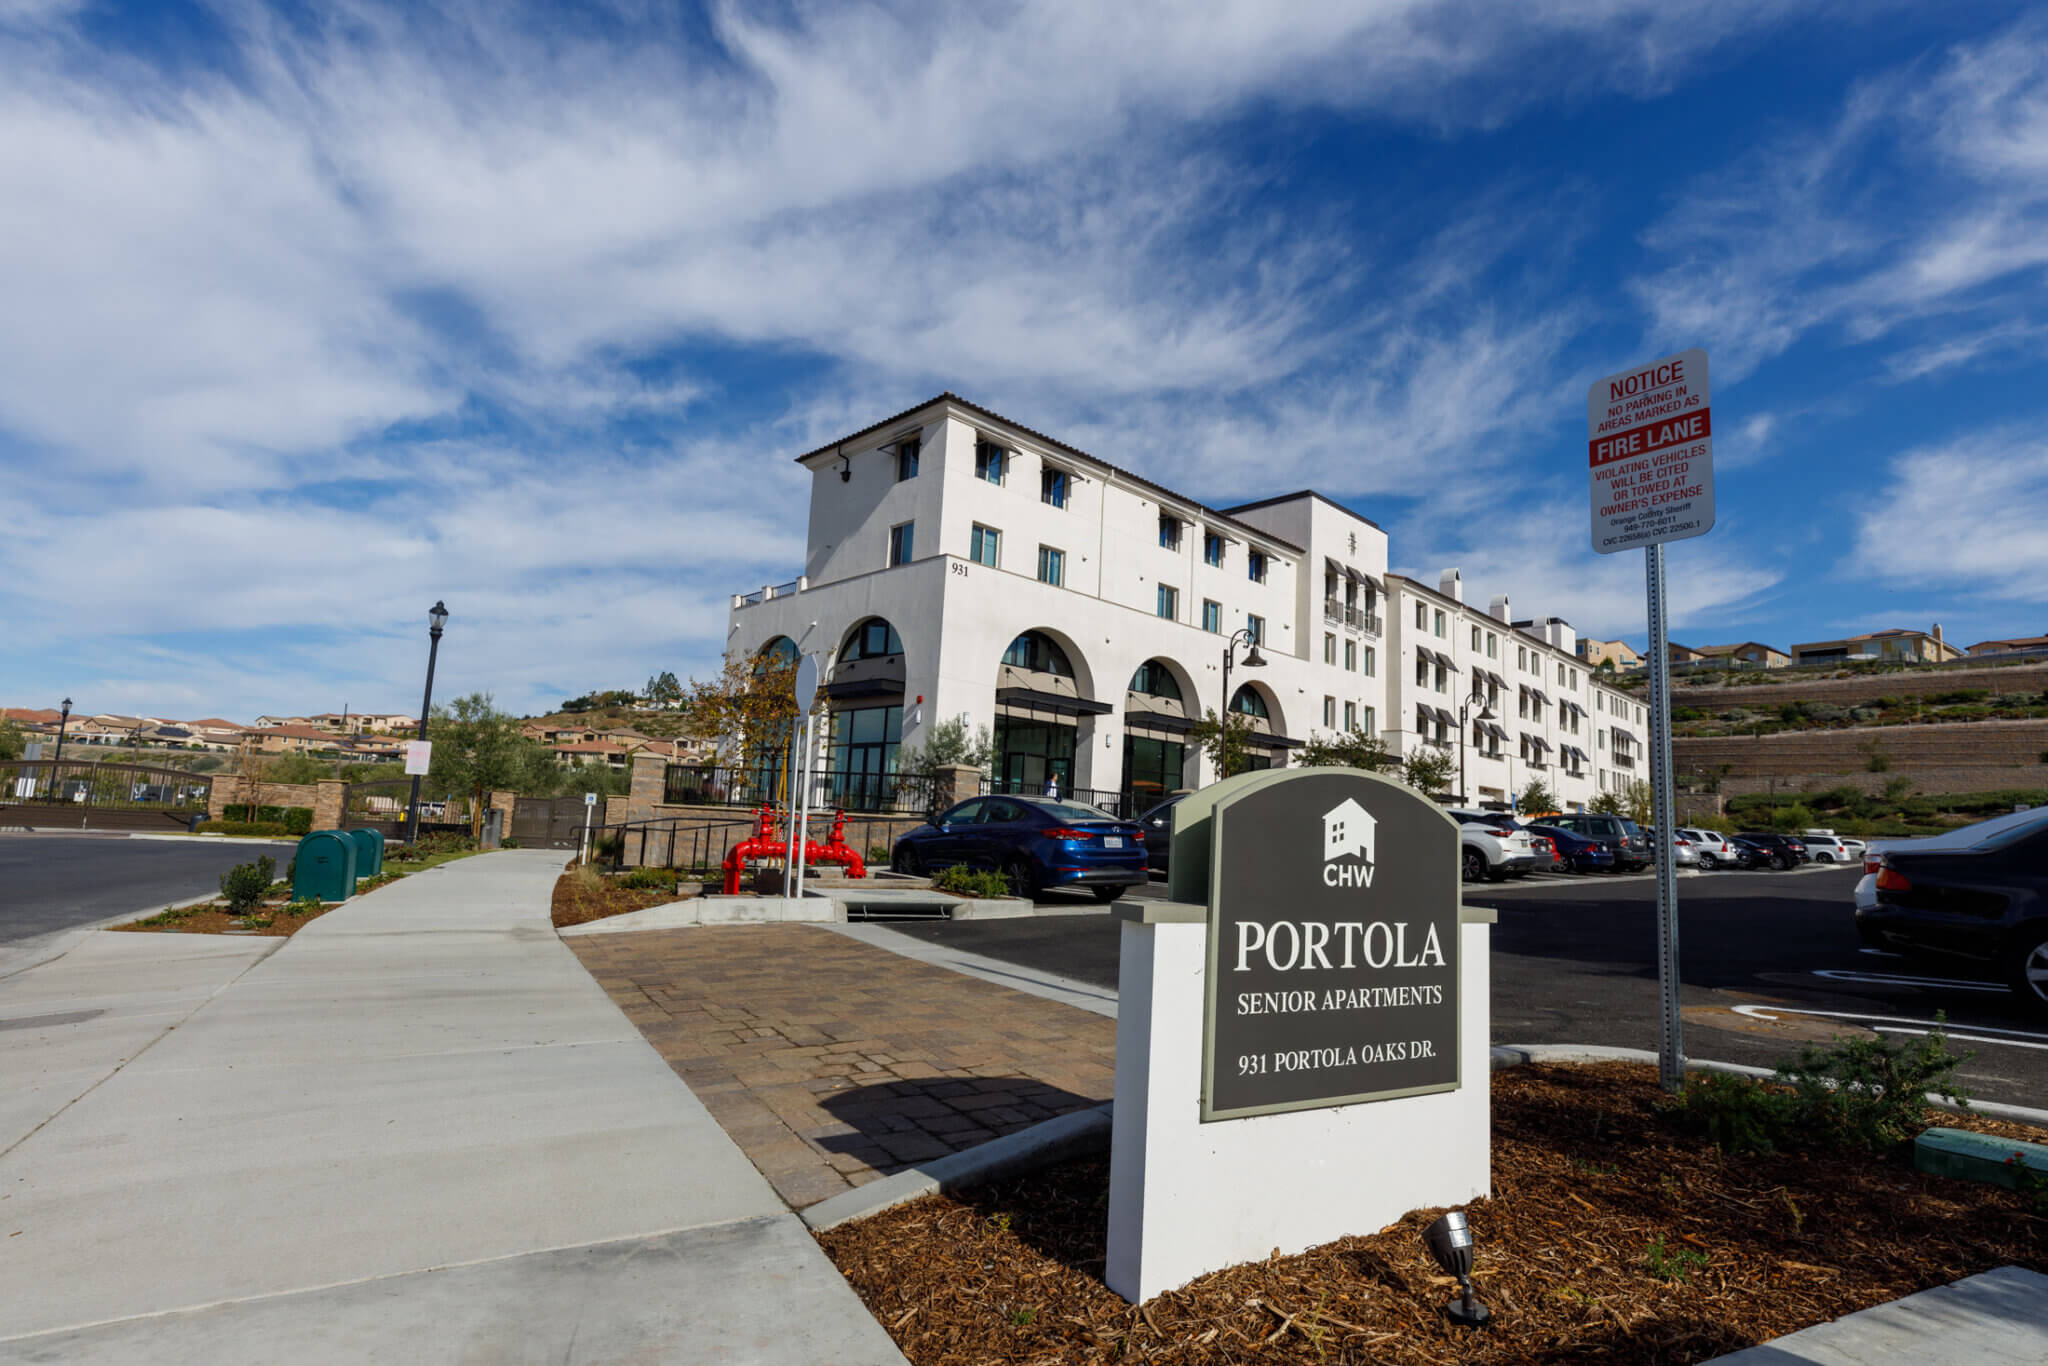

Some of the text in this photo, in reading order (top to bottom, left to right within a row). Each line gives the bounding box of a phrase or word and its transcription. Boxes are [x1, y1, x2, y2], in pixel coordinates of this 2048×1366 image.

[1610, 360, 1684, 400] NOTICE
[1598, 394, 1700, 433] AREAS MARKED AS
[1608, 385, 1687, 418] NO PARKING IN
[1597, 416, 1703, 461] FIRE LANE
[1595, 444, 1706, 481] VIOLATING VEHICLES
[1611, 462, 1689, 489] WILL BE CITED
[1600, 485, 1703, 517] OWNER'S EXPENSE
[1613, 476, 1687, 502] OR TOWED AT
[1638, 510, 1663, 521] County
[1665, 502, 1692, 515] Sheriff
[1652, 526, 1667, 537] CVC
[952, 562, 968, 577] 931
[1323, 864, 1375, 888] CHW
[1233, 920, 1447, 972] PORTOLA
[1237, 985, 1443, 1016] SENIOR APARTMENTS
[1239, 1040, 1437, 1076] 931 PORTOLA OAKS DR.
